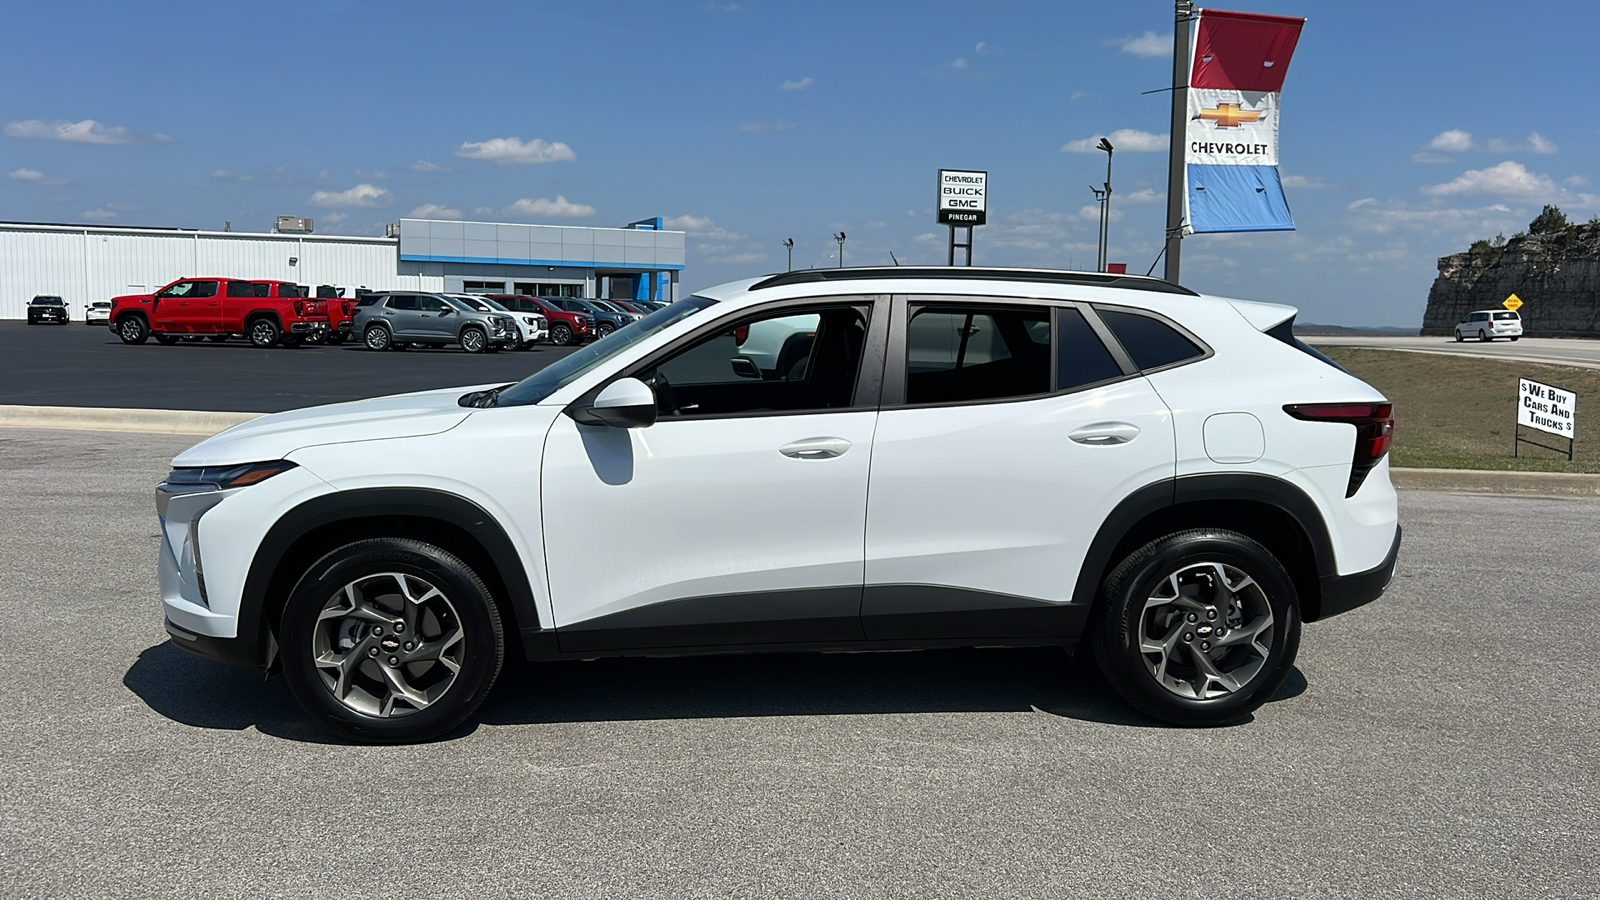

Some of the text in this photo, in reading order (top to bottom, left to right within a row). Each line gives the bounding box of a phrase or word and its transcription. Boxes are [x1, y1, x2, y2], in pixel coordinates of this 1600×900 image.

[1191, 141, 1268, 155] CHEVROLET
[944, 176, 983, 184] CHEVROLET
[944, 188, 982, 196] BUICK
[948, 200, 978, 208] GMC
[1528, 383, 1545, 399] WE
[1548, 389, 1567, 404] BUY
[1524, 396, 1570, 419] CARS AND
[1529, 411, 1563, 431] TRUCKS
